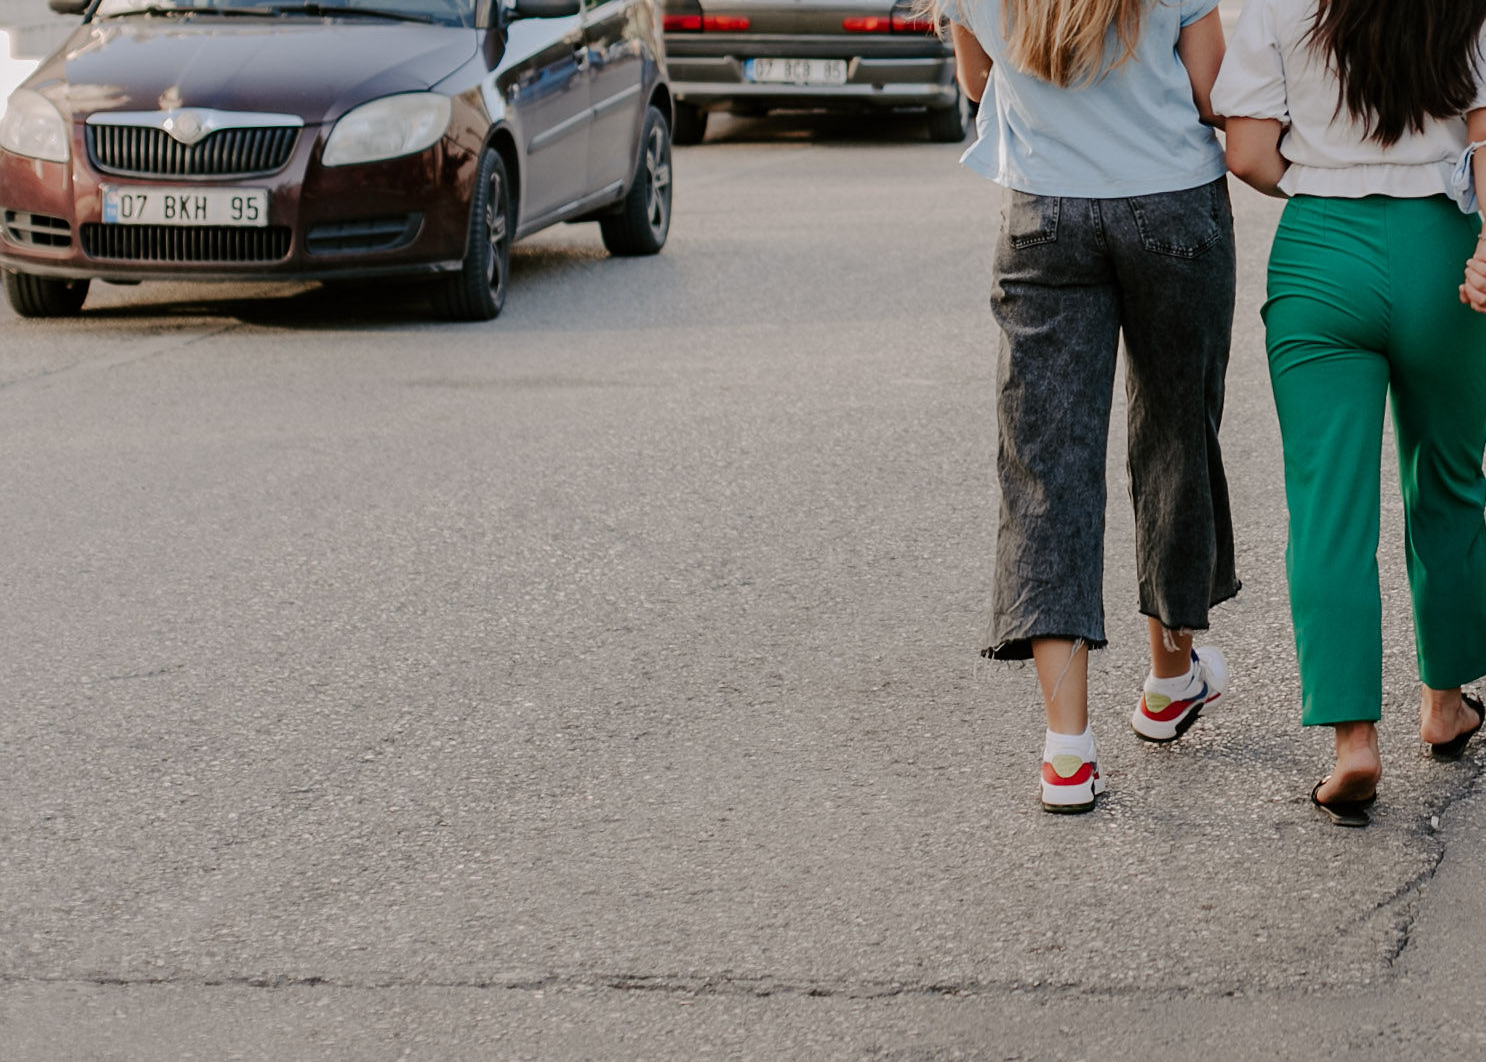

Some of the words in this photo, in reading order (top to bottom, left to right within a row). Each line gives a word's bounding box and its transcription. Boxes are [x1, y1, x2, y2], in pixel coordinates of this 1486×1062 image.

[121, 195, 147, 219] 07
[165, 195, 207, 220] BKH
[231, 196, 259, 220] 95
